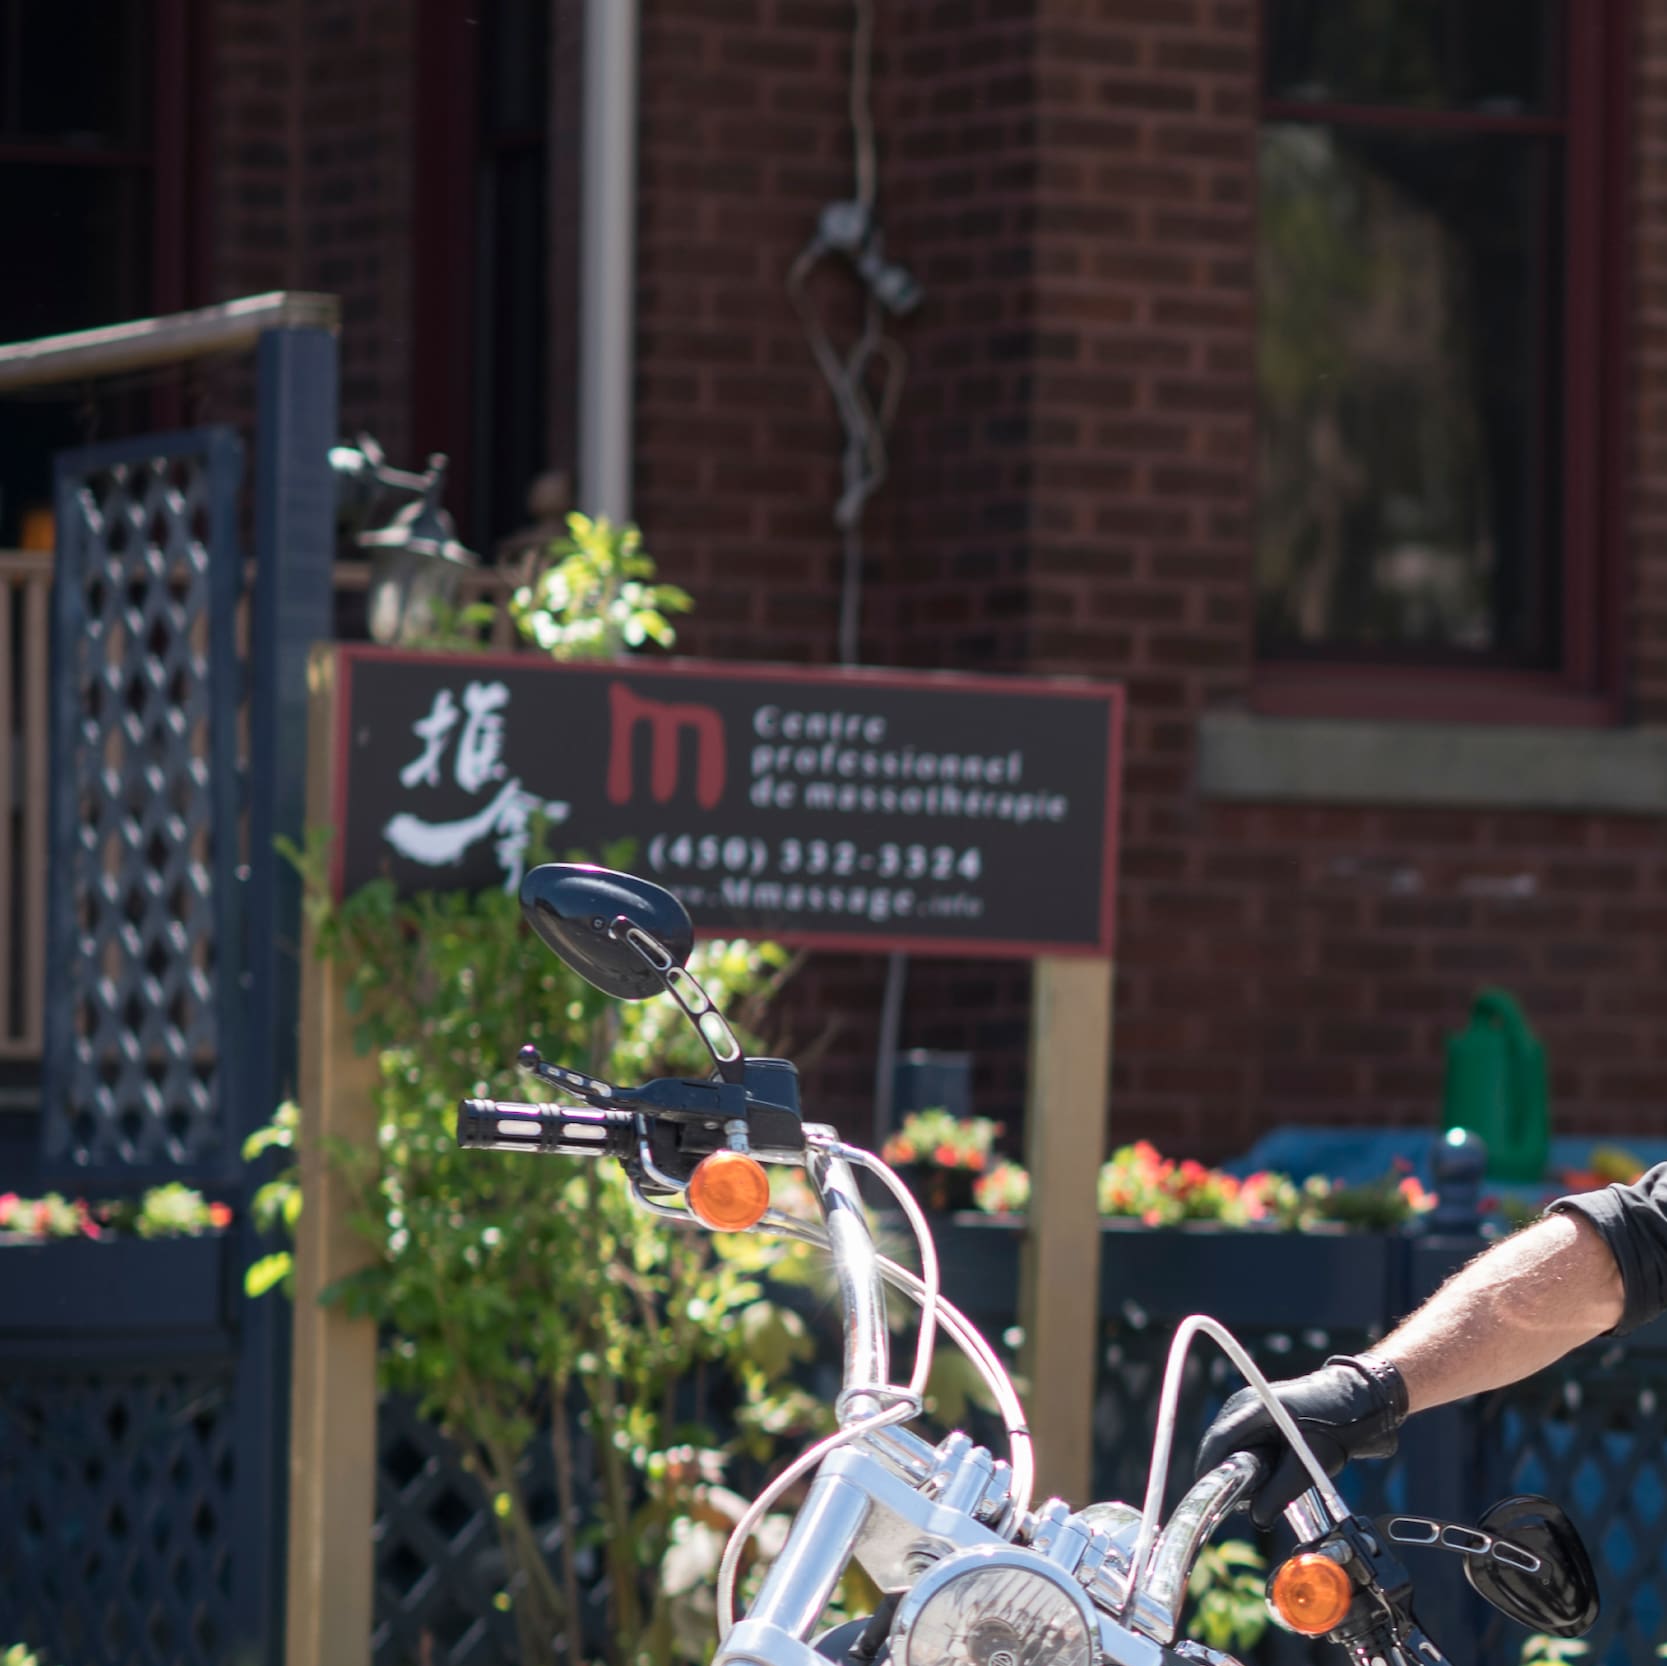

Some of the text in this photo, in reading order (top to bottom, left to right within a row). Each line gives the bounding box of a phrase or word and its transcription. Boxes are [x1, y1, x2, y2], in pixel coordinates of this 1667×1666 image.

[753, 705, 887, 743] Centre
[751, 744, 1023, 784] professionnel
[750, 774, 797, 808] de
[648, 834, 982, 880] (450) 332-3324
